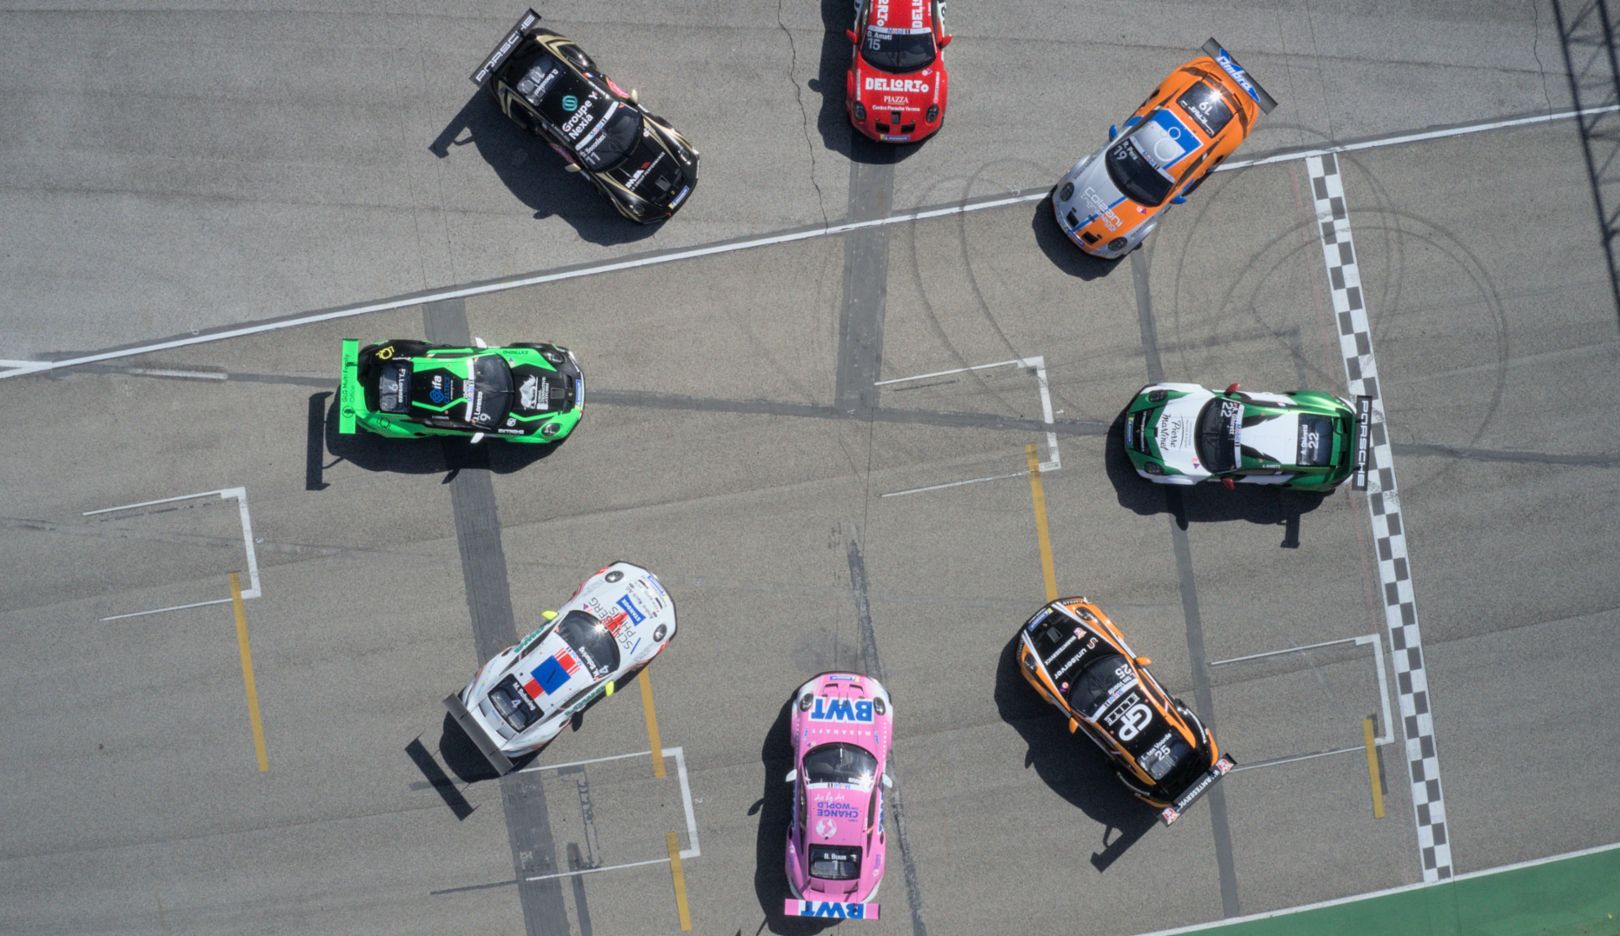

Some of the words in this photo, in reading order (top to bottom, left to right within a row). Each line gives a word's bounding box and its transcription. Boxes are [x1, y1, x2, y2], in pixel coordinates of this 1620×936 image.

[476, 15, 534, 81] PORSCHE
[867, 38, 880, 50] 15
[864, 77, 929, 92] DELLORTO
[883, 95, 908, 103] PIAZZA
[563, 100, 592, 132] Groupe
[589, 91, 597, 99] Y
[1199, 100, 1212, 115] 19
[569, 114, 593, 139] Nexia
[586, 152, 600, 164] 11
[1114, 146, 1127, 159] 19
[432, 374, 442, 389] ifa
[1221, 401, 1234, 417] 22
[480, 413, 490, 421] 9
[1308, 433, 1319, 448] 22
[1356, 400, 1370, 487] PORSCHE
[600, 665, 610, 675] 4
[1055, 649, 1086, 678] uniserver
[1116, 664, 1131, 678] 25
[511, 699, 521, 708] 4
[812, 698, 873, 721] BWT
[1105, 693, 1139, 725] ELITE
[1121, 704, 1152, 740] GP
[1155, 745, 1170, 760] 25
[1178, 770, 1219, 811] WRMTESERVIC
[817, 809, 859, 818] CHANGE
[801, 900, 864, 919] BWT
